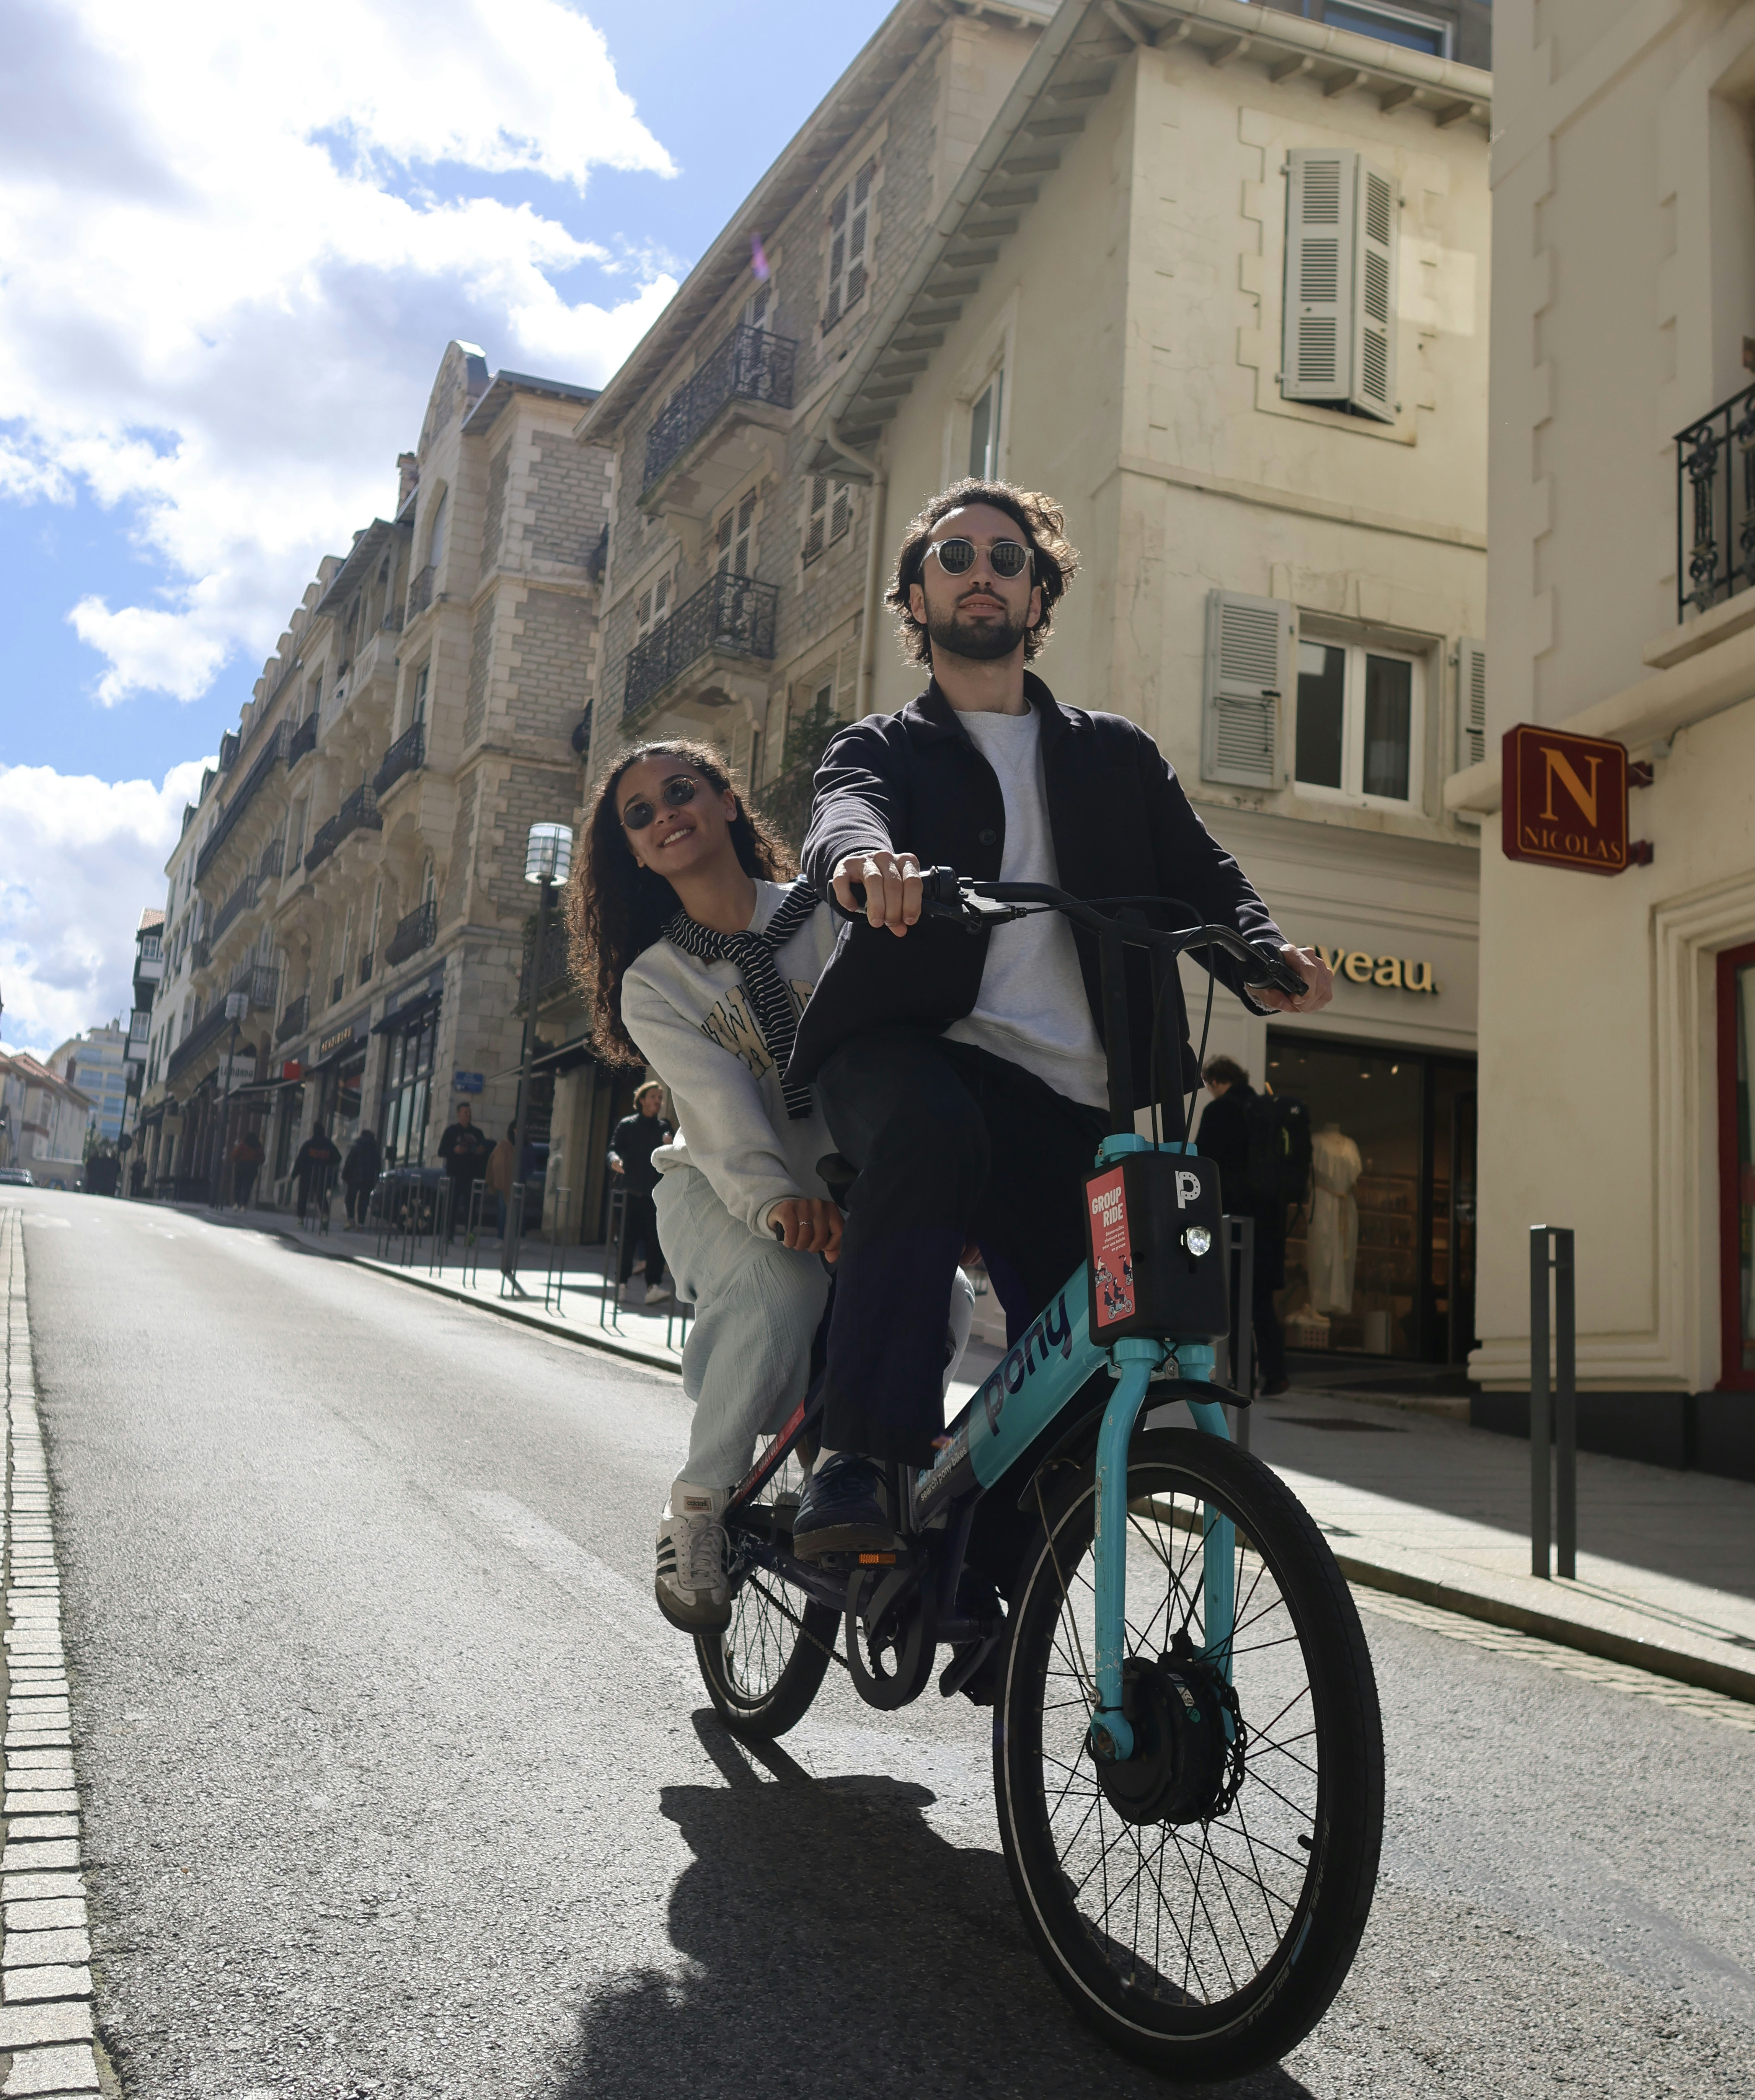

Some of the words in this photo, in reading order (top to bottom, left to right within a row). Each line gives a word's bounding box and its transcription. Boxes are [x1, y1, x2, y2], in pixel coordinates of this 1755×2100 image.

[1540, 747, 1603, 827] N
[1525, 826, 1621, 860] NICOLAS
[1092, 1186, 1122, 1214] GROUP
[1103, 1203, 1124, 1227] RIDE
[1104, 1235, 1117, 1243] plusieurs
[1105, 1225, 1124, 1237] Déverrouillez
[1116, 1243, 1126, 1251] groupe
[984, 1292, 1073, 1437] pony
[920, 1477, 939, 1501] search
[938, 1463, 952, 1484] pony
[951, 1447, 967, 1467] bikes
[1312, 1818, 1330, 1910] SCALBE
[1277, 1966, 1290, 1991] BIG
[1248, 1990, 1275, 2026] APPLE
